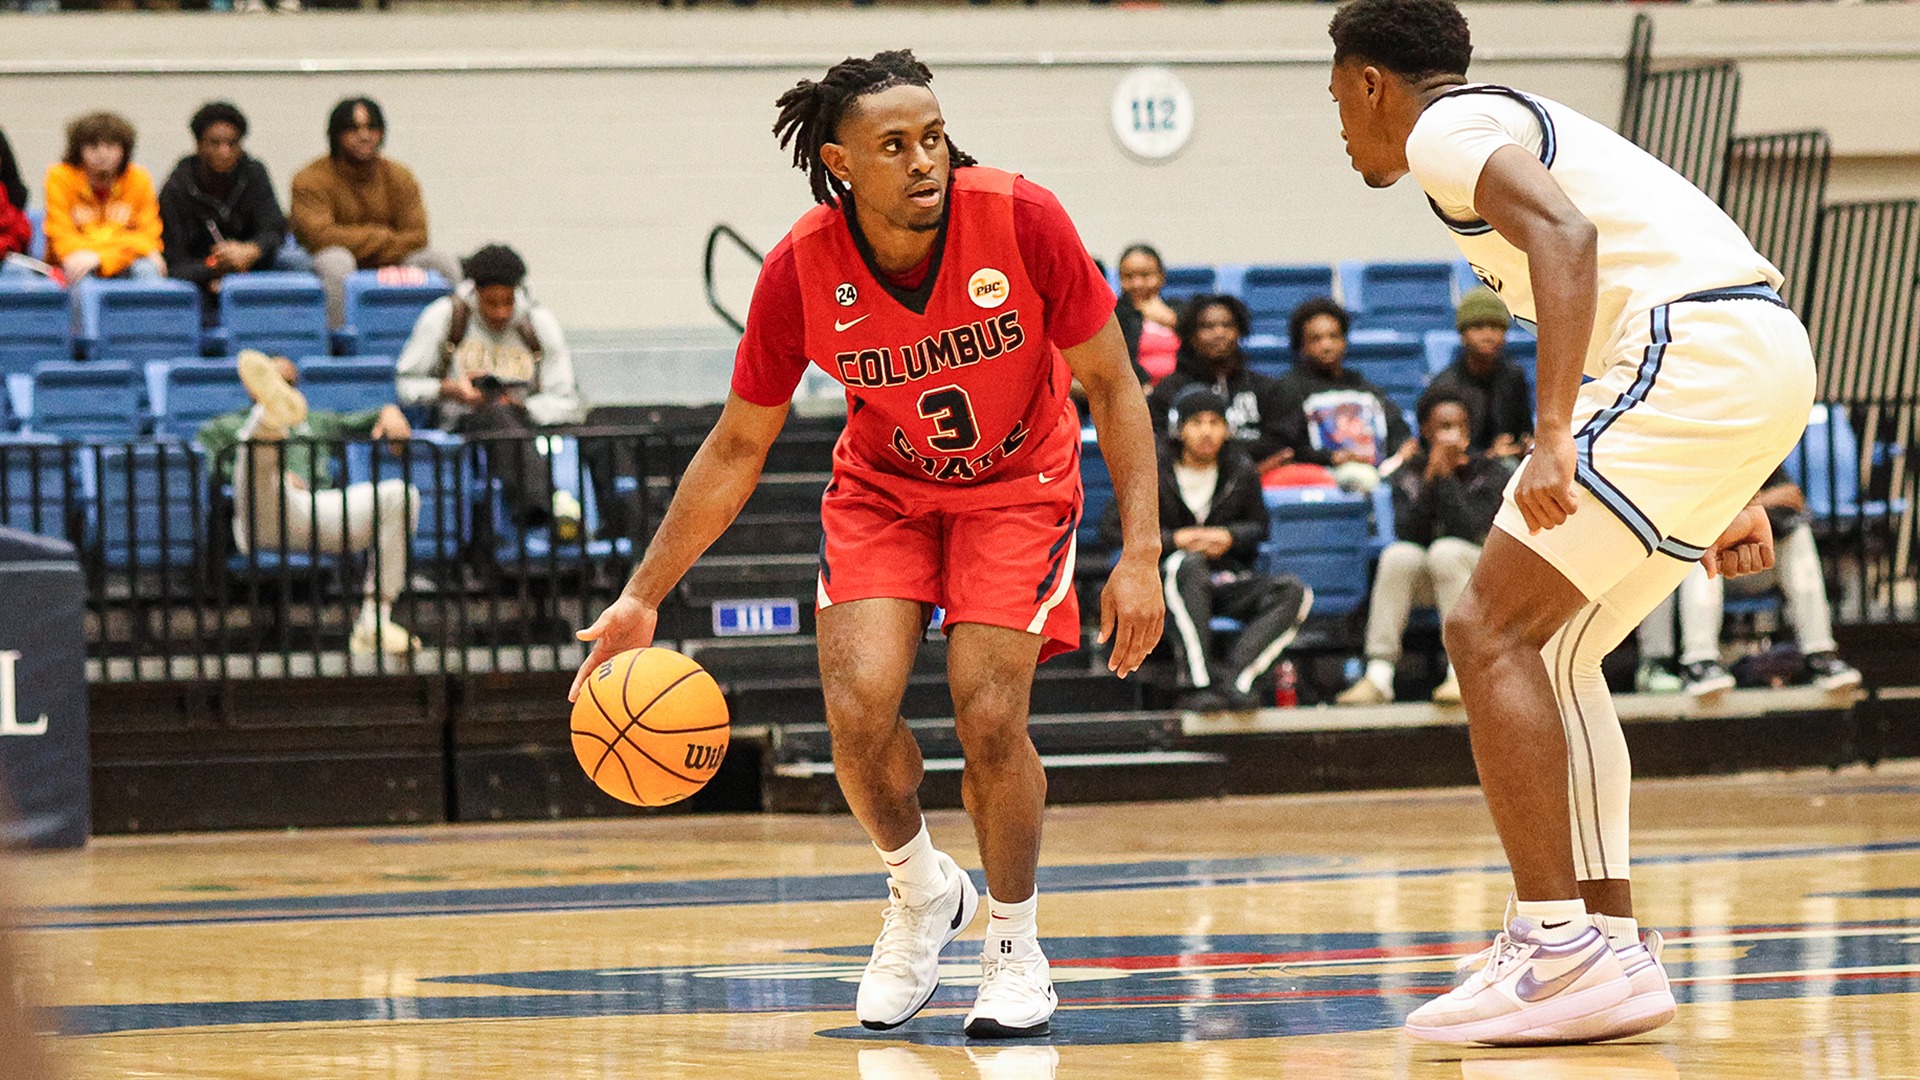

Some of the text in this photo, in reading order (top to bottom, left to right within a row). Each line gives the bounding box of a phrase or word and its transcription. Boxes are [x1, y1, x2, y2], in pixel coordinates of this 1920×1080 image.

[1132, 97, 1176, 131] 112
[837, 286, 856, 303] 24
[977, 281, 1000, 296] PBC
[835, 310, 1025, 388] COLUMBUS
[916, 384, 981, 452] 3
[684, 743, 726, 770] Wil
